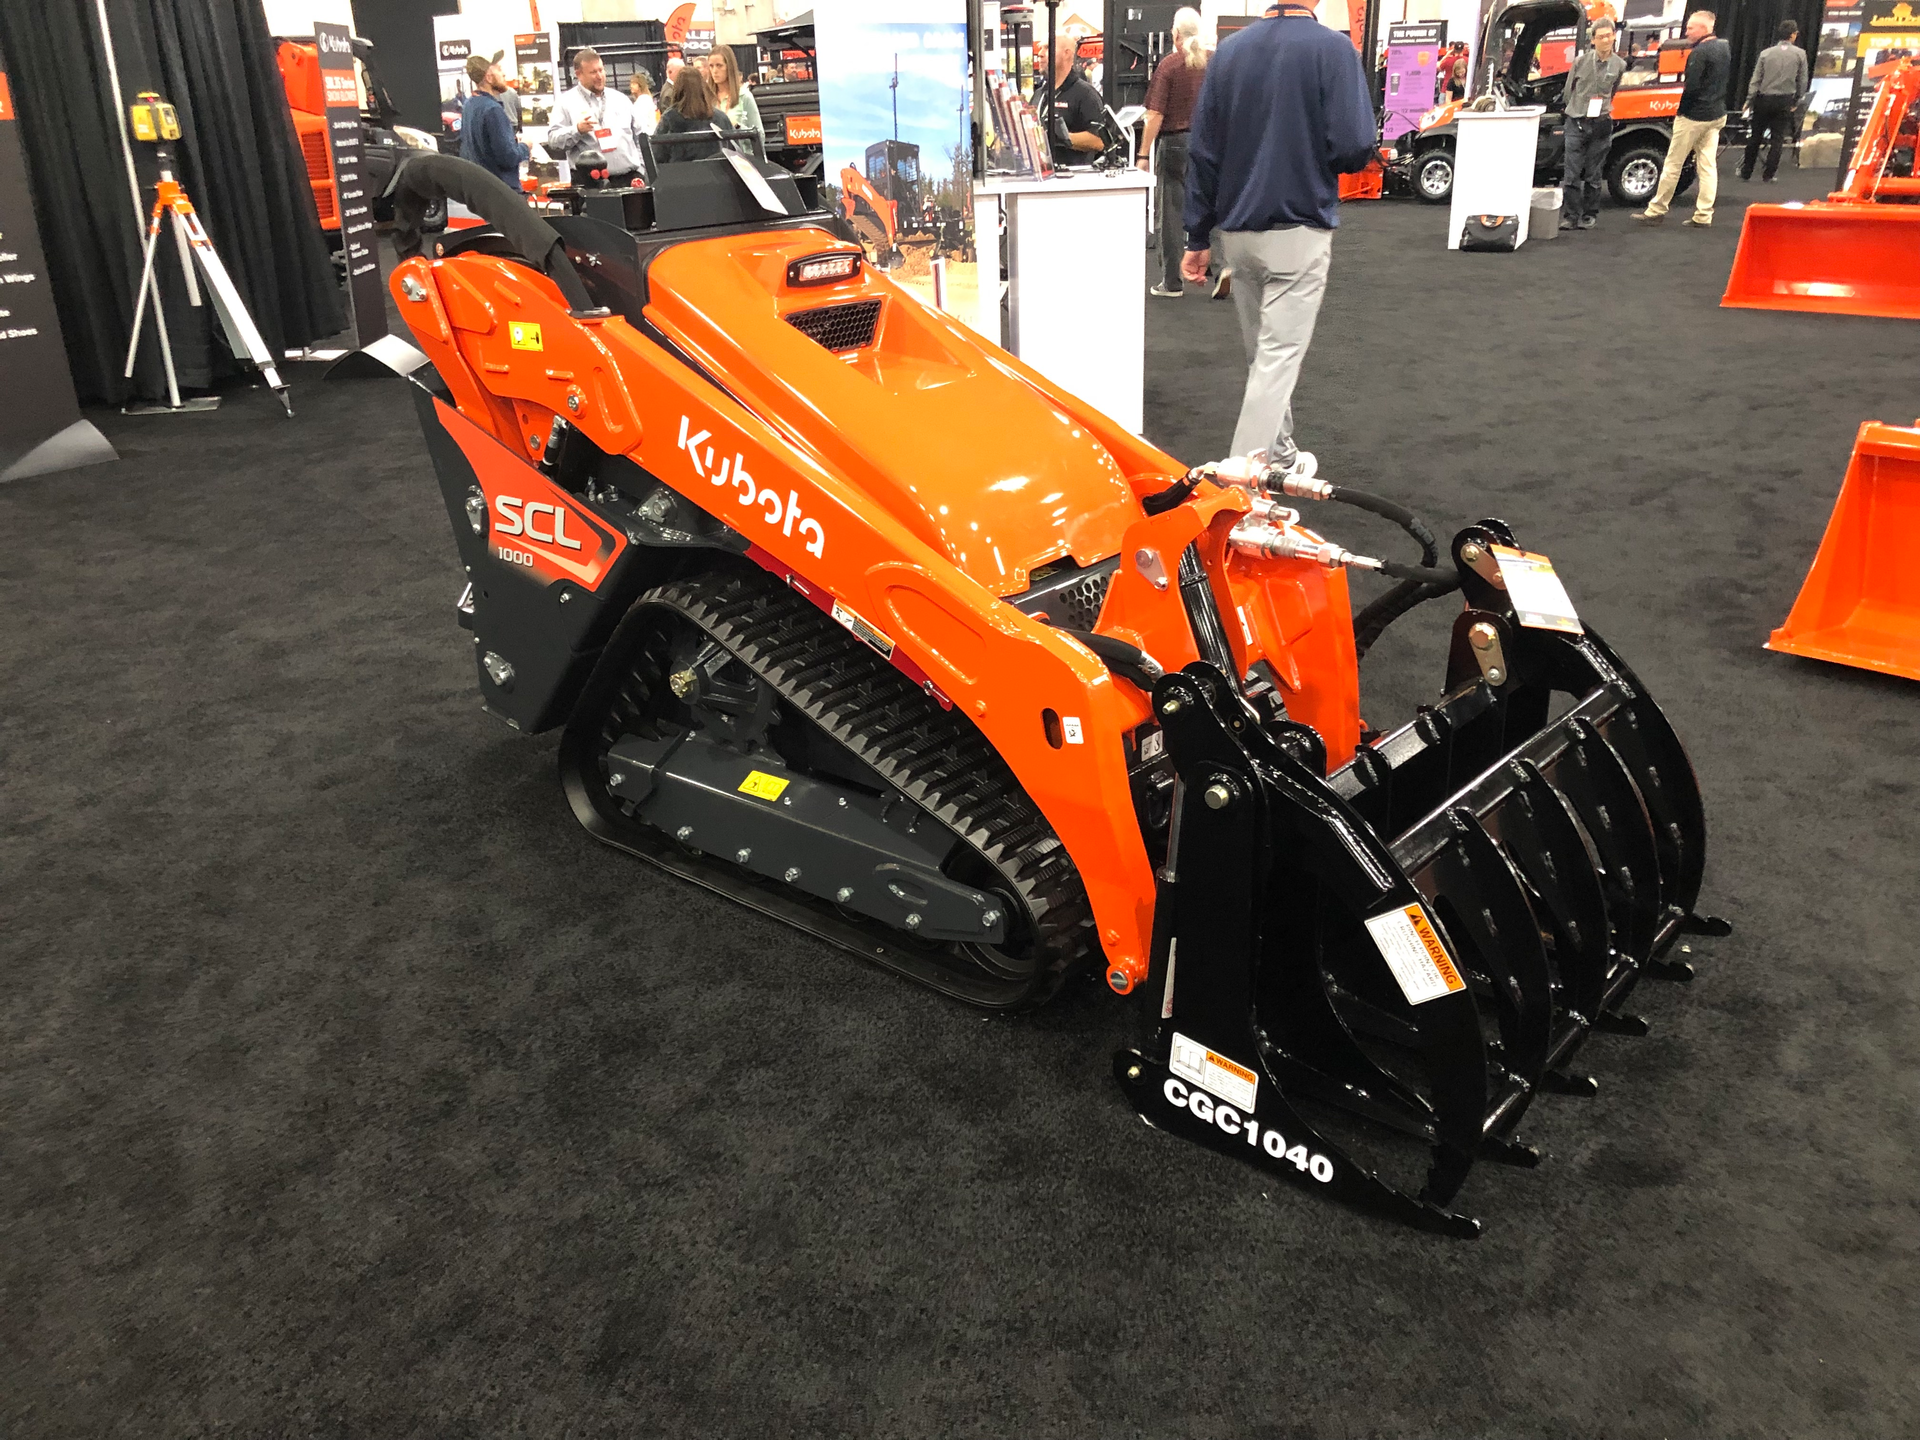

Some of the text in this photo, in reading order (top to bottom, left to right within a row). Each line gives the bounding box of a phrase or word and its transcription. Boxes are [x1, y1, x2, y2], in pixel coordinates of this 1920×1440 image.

[1650, 100, 1680, 111] Kubo
[789, 128, 821, 139] Kubota
[4, 273, 36, 284] Wings
[8, 328, 39, 338] Shoes
[677, 414, 825, 560] Kubota
[494, 494, 582, 551] SCL
[497, 546, 533, 567] 1000
[1418, 926, 1458, 985] WARNING
[1216, 1057, 1254, 1083] WARNING
[1163, 1078, 1334, 1183] CGC1040
